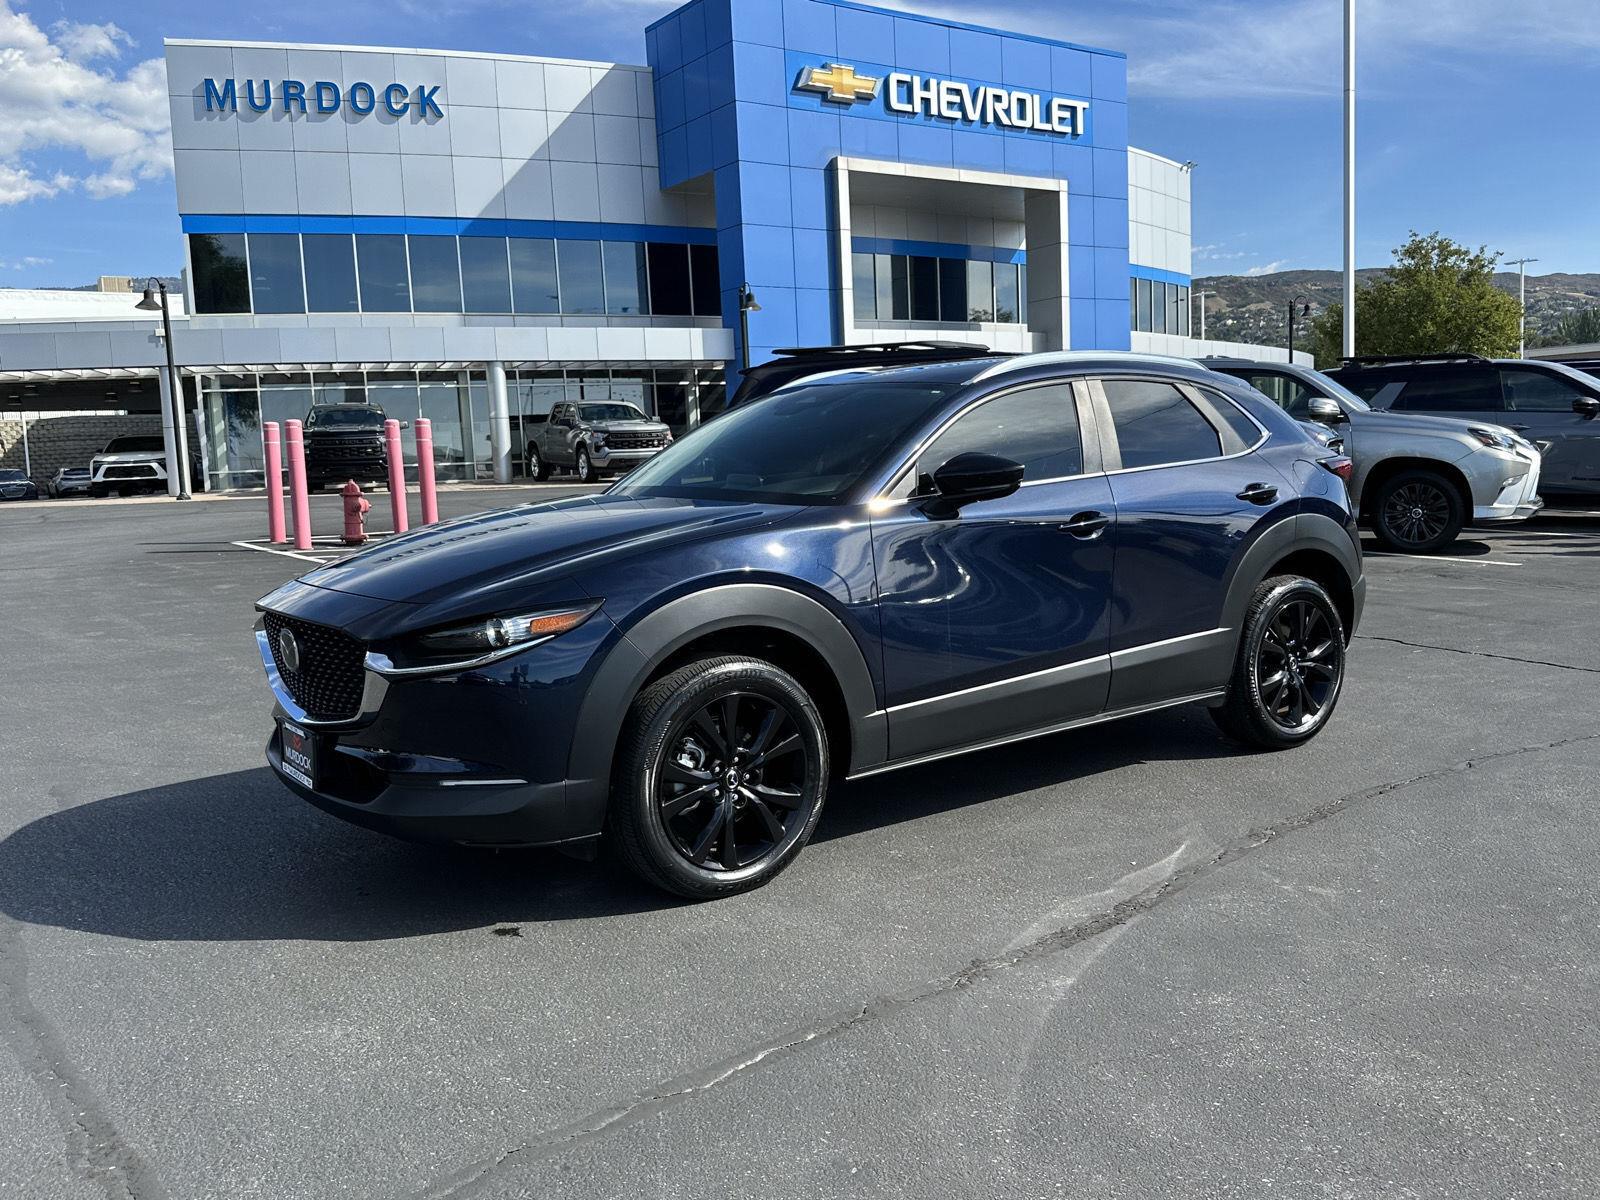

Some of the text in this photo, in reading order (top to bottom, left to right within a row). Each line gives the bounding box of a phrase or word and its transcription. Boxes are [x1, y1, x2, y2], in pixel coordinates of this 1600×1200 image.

[204, 78, 444, 118] MURDOCK
[889, 72, 1089, 135] CHEVROLET
[285, 745, 312, 771] MURDOCK
